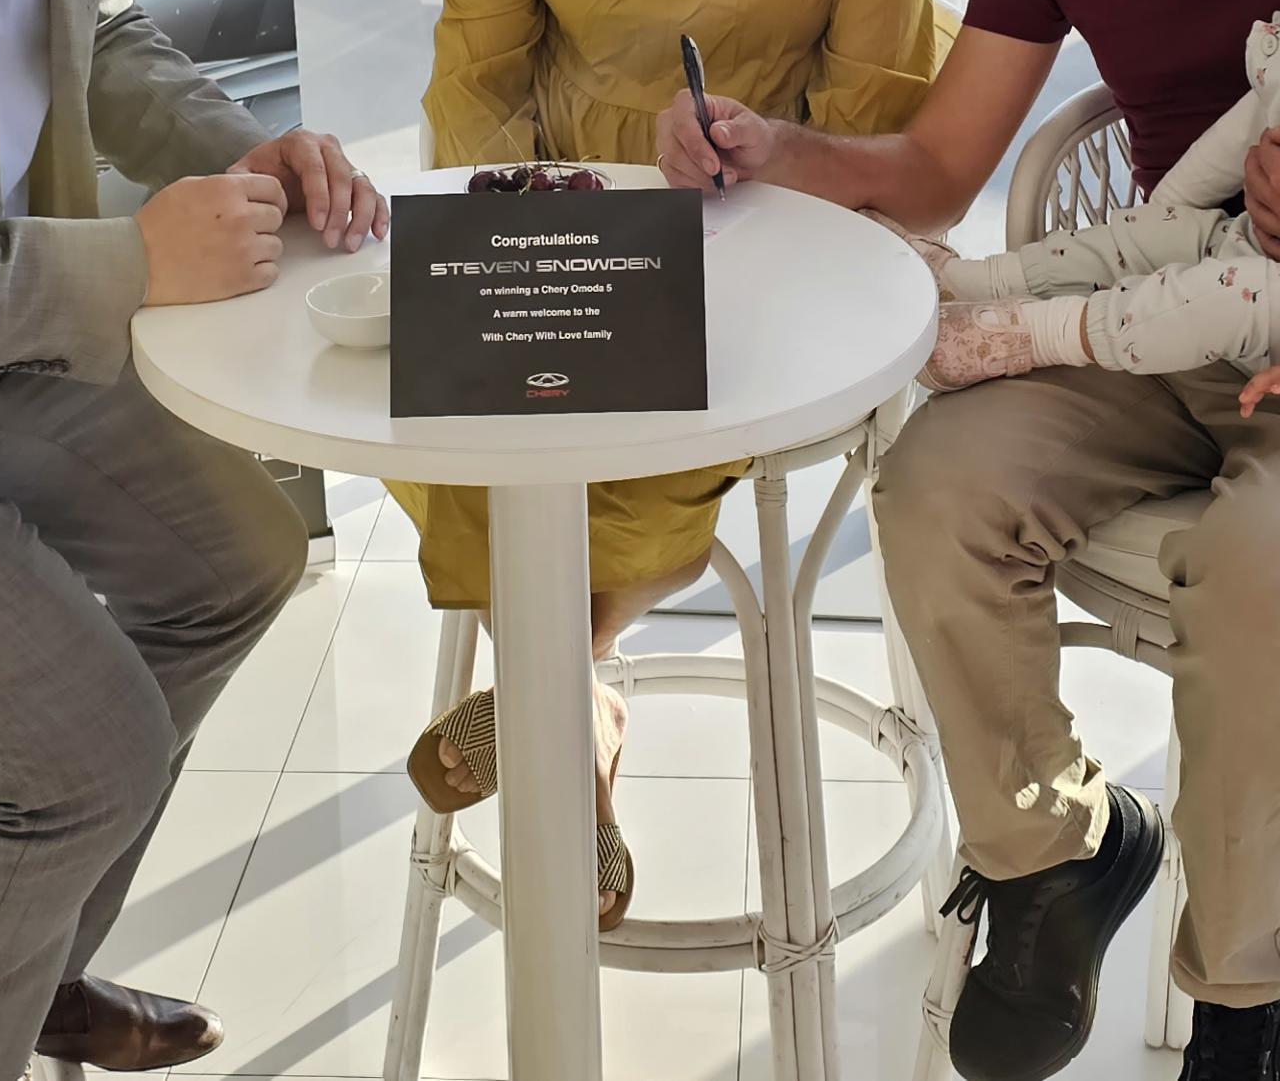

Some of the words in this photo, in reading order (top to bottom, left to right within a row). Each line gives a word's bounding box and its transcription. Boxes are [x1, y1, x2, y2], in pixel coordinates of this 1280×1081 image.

[491, 233, 600, 249] Congratulations
[430, 260, 530, 276] STEVEN
[536, 257, 661, 273] SNOWDEN
[480, 288, 492, 296] on
[494, 285, 531, 296] winning
[533, 287, 540, 295] a
[541, 285, 569, 295] Chery
[571, 284, 604, 294] Omoda
[606, 283, 613, 293] 5
[493, 310, 501, 319] A
[503, 309, 528, 318] warm
[530, 308, 571, 318] welcome
[573, 307, 583, 316] to
[585, 307, 600, 316] the
[482, 332, 503, 342] With
[505, 331, 534, 343] Chery
[535, 331, 556, 341] With
[559, 330, 582, 340] Love
[583, 329, 612, 341] family
[526, 389, 570, 398] CHERY
